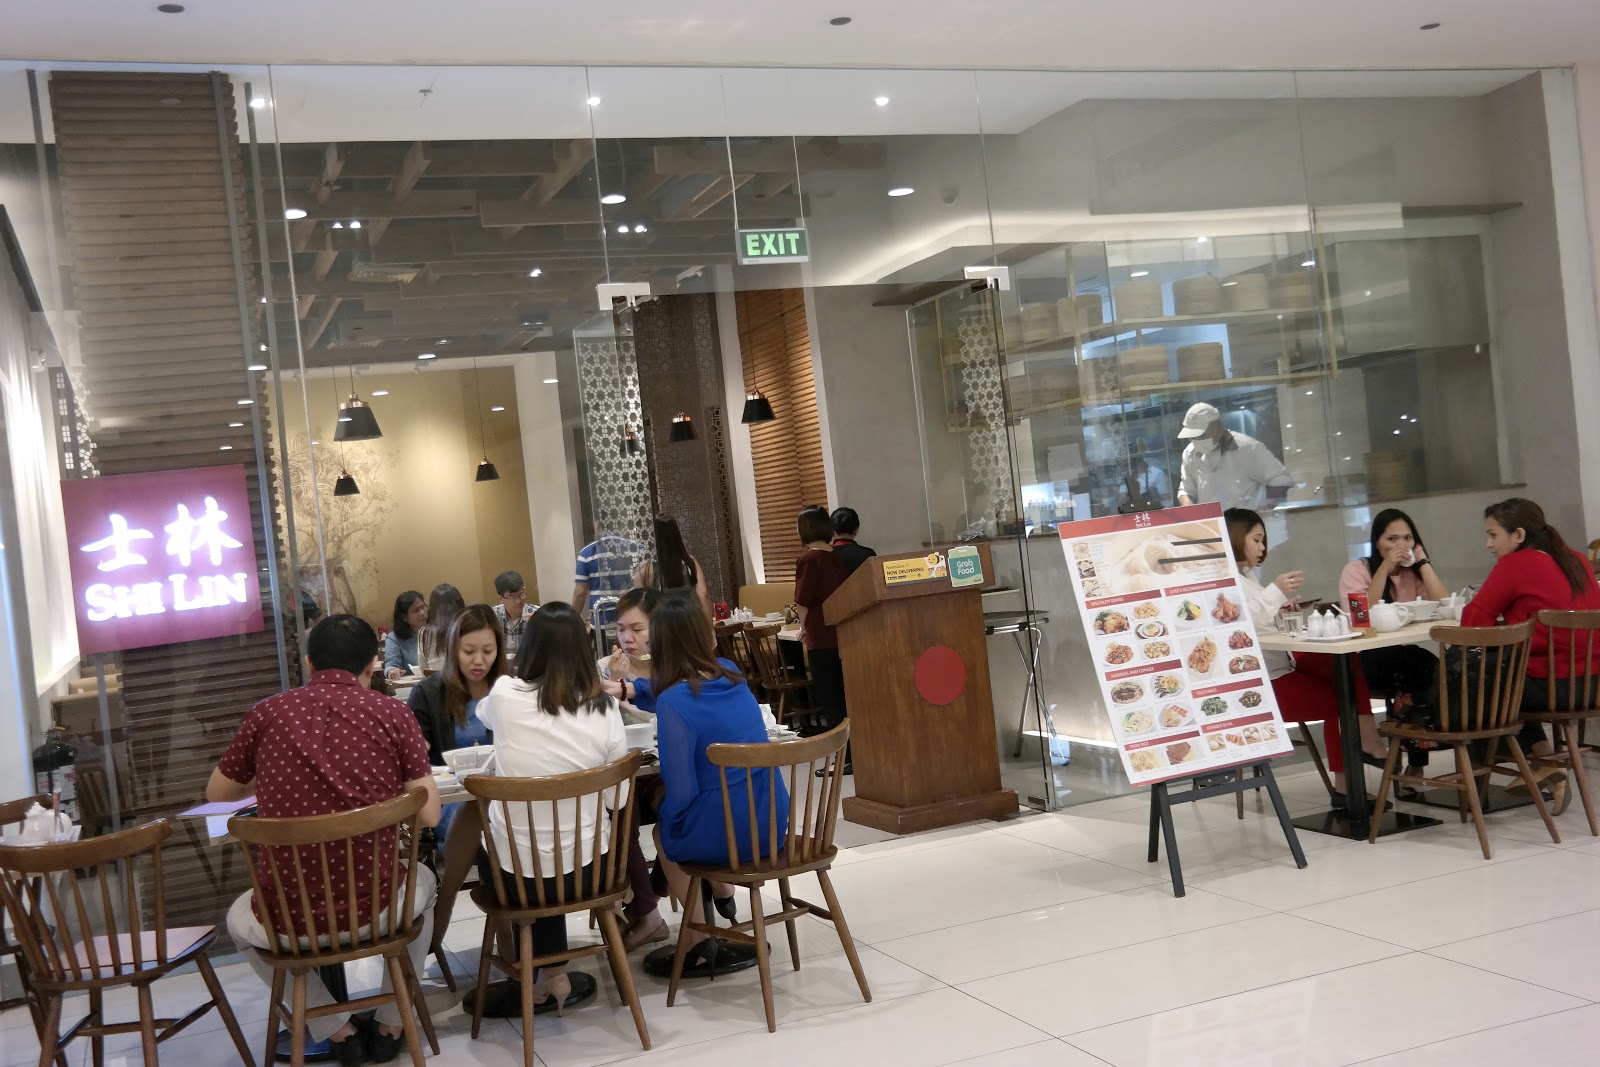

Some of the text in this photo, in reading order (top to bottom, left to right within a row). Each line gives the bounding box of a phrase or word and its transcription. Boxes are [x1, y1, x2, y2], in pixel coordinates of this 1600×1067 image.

[745, 233, 800, 256] EXIT
[80, 495, 244, 573] 士林
[956, 559, 974, 569] Grab
[957, 566, 975, 575] Food
[898, 567, 924, 575] DELIVERING
[84, 572, 248, 622] SHI LIN
[1110, 670, 1130, 679] NOODLES
[1138, 666, 1155, 674] CONGEE
